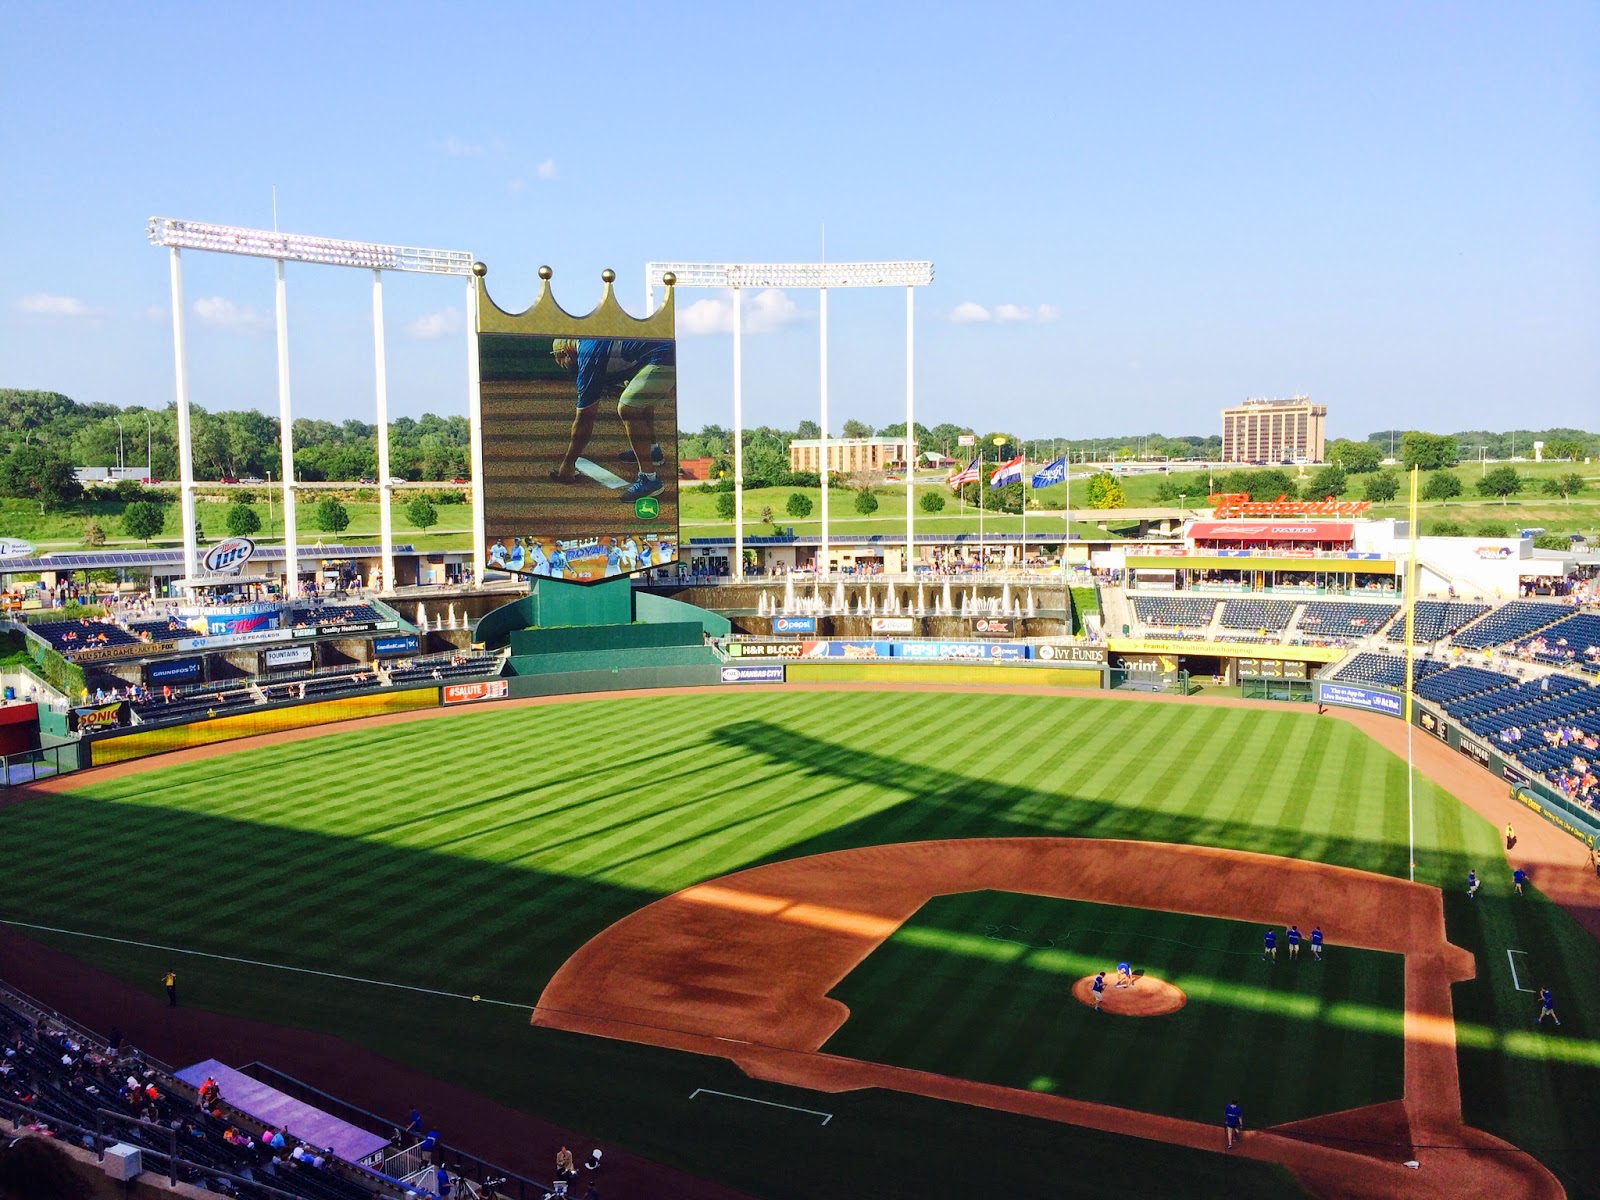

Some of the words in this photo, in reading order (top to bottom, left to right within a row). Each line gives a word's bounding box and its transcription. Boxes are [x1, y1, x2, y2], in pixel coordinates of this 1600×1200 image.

[1207, 492, 1371, 518] Budweiser
[563, 540, 578, 550] BE
[211, 622, 226, 633] IT'S
[226, 614, 268, 635] Miller
[341, 624, 368, 632] Healthcare
[376, 621, 398, 629] TEVA
[788, 621, 810, 629] pepsi
[293, 629, 317, 637] TEVA
[113, 647, 133, 656] GAME
[743, 645, 764, 654] H&R
[767, 645, 800, 654] BLOCK
[903, 644, 936, 656] PEPSI
[940, 645, 985, 657] PORCH
[269, 650, 299, 659] FOUNTAINS
[1117, 659, 1157, 674] Sprint
[153, 668, 189, 677] GRUNDFOS
[767, 669, 781, 677] CITY
[449, 686, 482, 696] #SALUTE
[81, 709, 118, 724] SONIC
